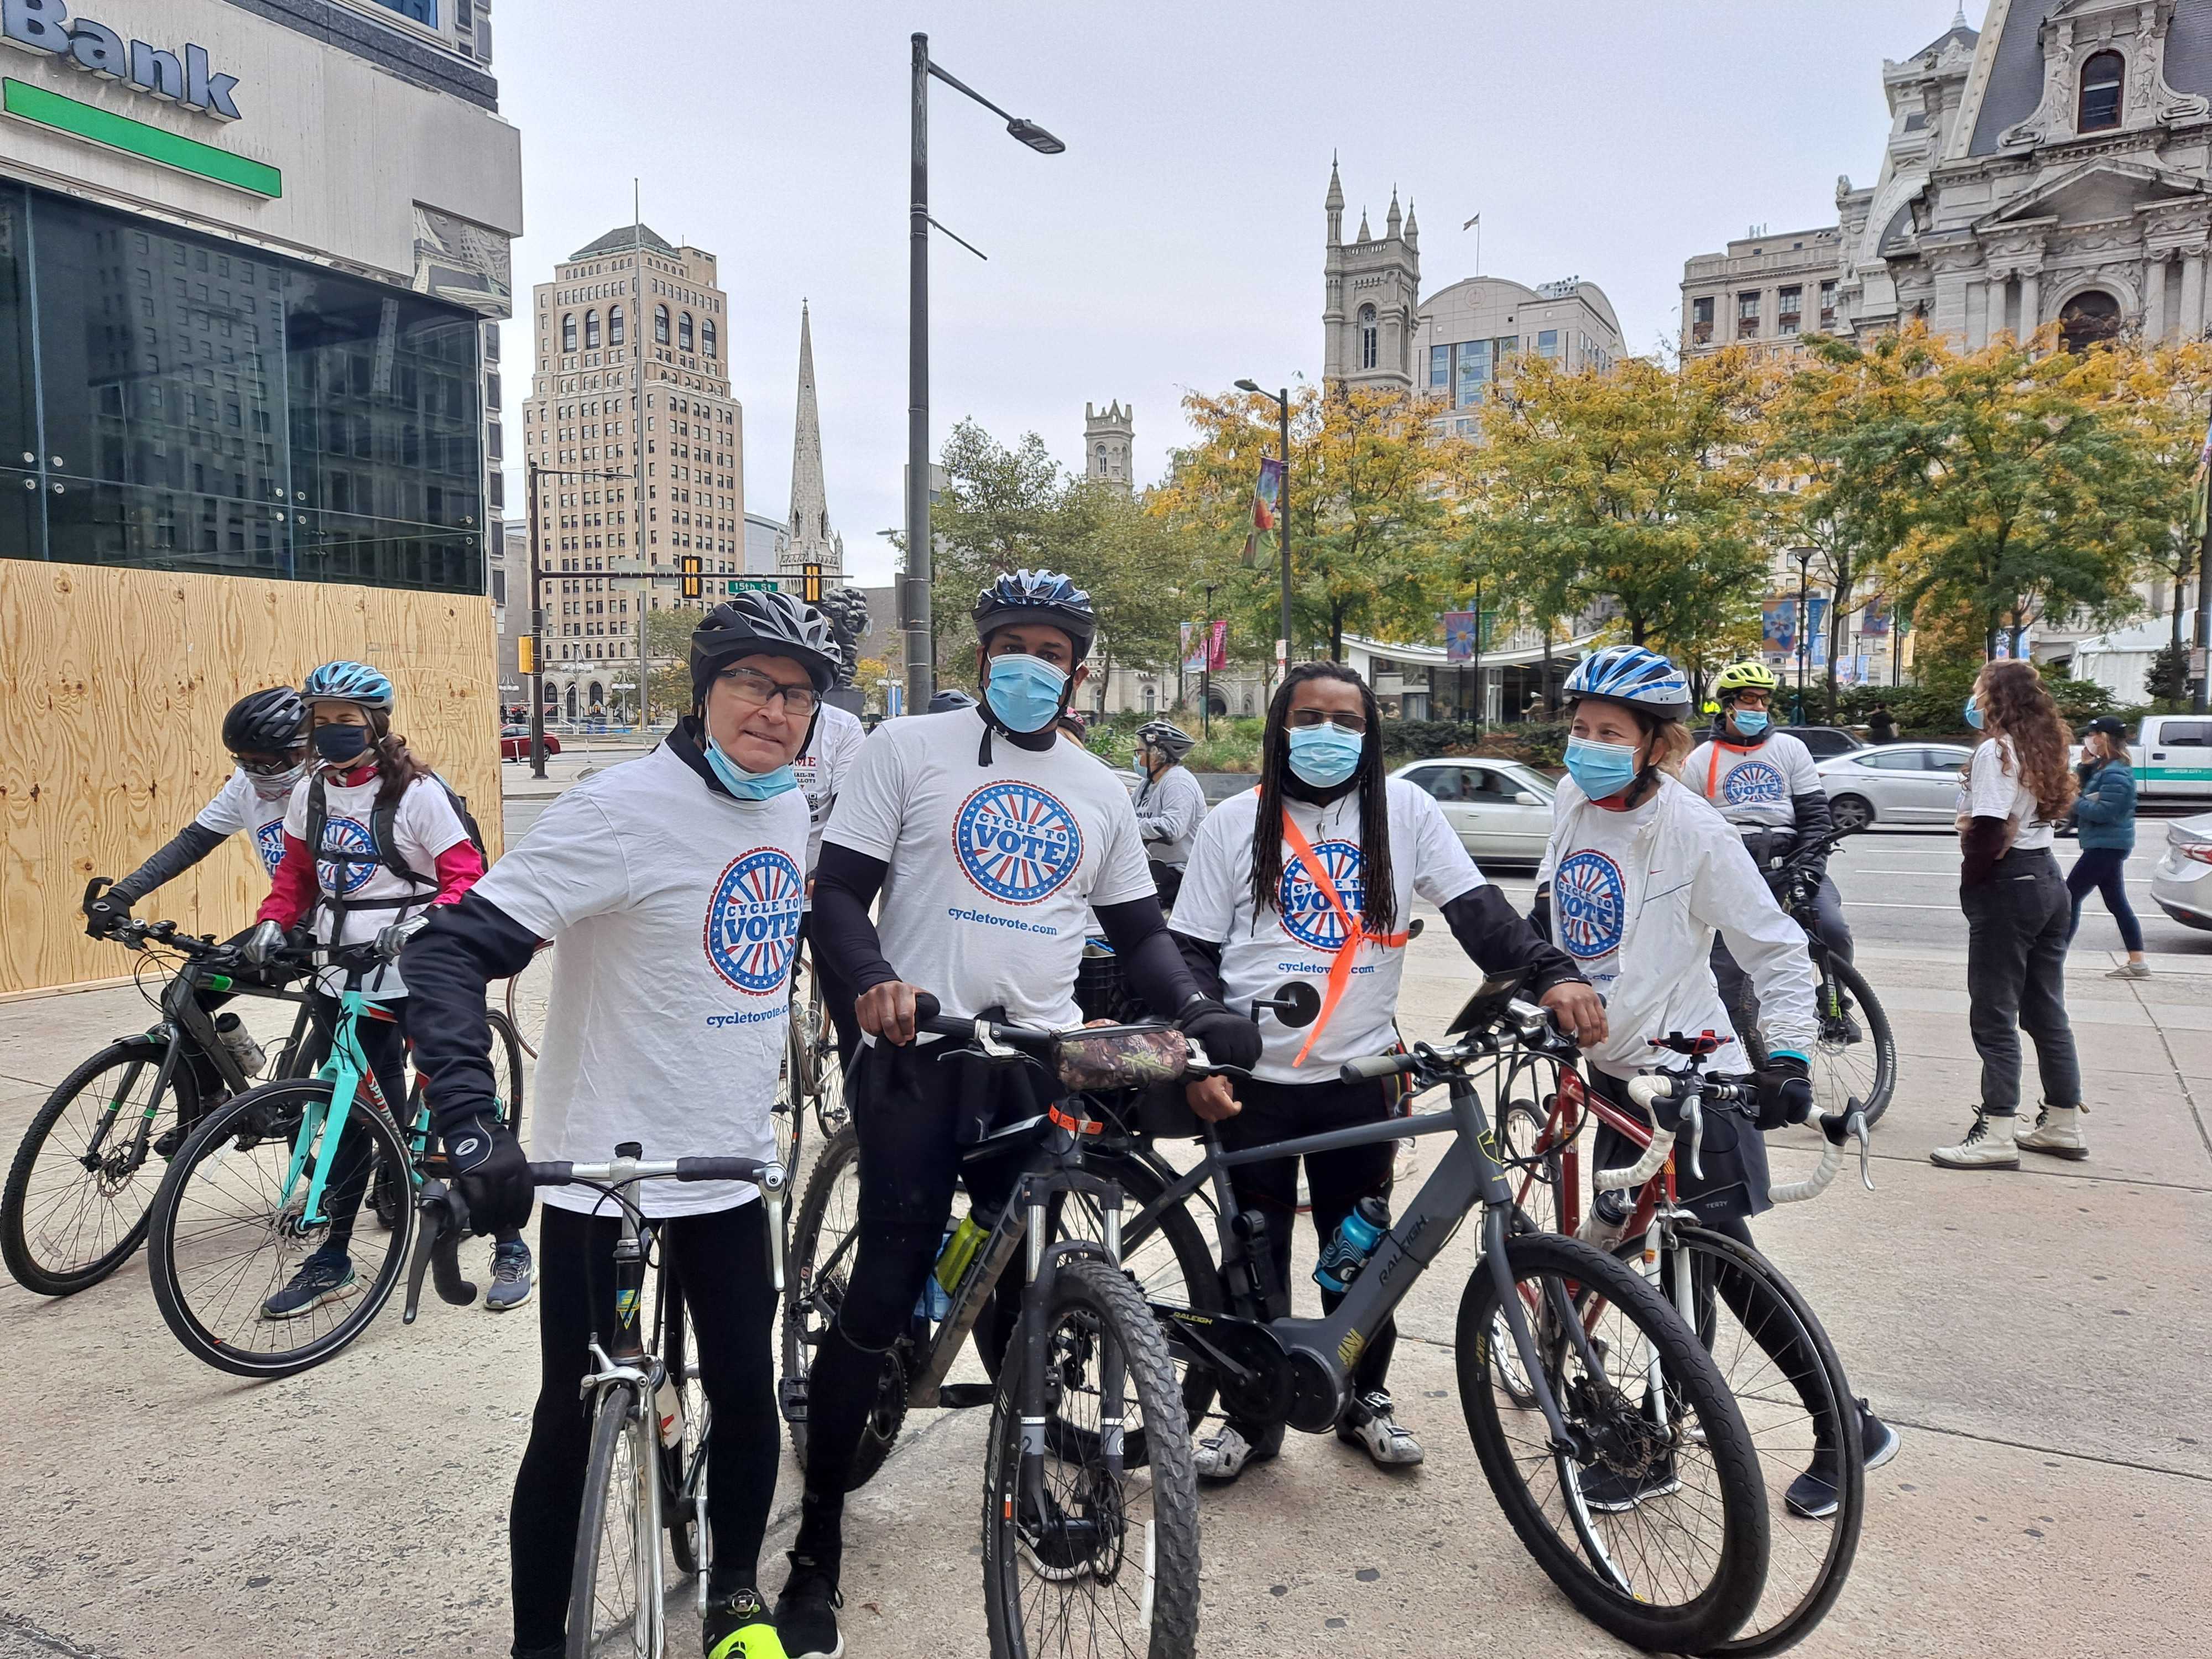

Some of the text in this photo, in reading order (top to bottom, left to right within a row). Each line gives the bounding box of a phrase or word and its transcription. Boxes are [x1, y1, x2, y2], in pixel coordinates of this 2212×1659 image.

[2, 0, 242, 121] Bank
[735, 582, 755, 591] 15th
[795, 757, 816, 767] ME
[1732, 784, 1776, 796] VOTE
[979, 813, 1066, 842] CYCLE TO
[260, 842, 284, 850] CYCL
[975, 823, 1066, 866] VOTE
[1293, 879, 1359, 893] CYE T
[1558, 881, 1612, 909] CYCLE TO
[727, 898, 799, 917] CYCLE TO
[1558, 890, 1613, 930] VOTE
[724, 910, 799, 945] VOTE
[948, 907, 1057, 936] cycletovote.com
[1278, 962, 1375, 974] cycletov.com
[706, 1004, 788, 1028] cycletovote.c
[1705, 1200, 1728, 1209] TERRY
[1379, 1214, 1427, 1287] RALEIGH
[1173, 1311, 1213, 1325] RALEIGH
